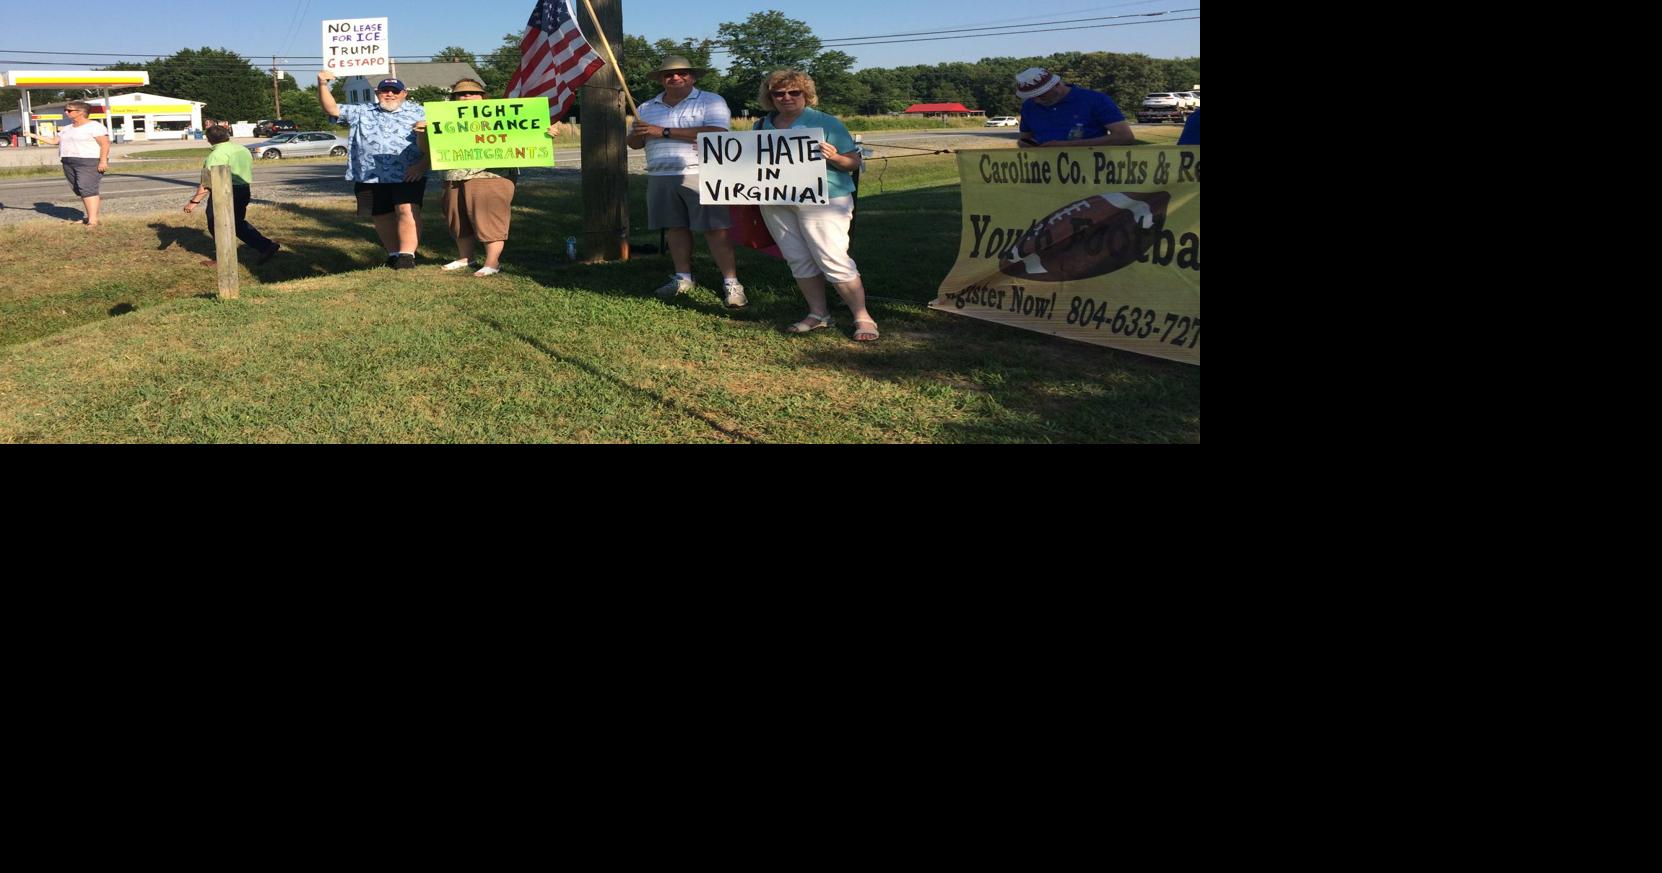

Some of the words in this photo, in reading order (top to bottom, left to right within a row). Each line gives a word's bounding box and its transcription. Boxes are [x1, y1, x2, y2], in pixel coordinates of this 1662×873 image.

[328, 22, 351, 33] NO
[353, 23, 383, 33] LEASE
[332, 34, 352, 42] FOR
[329, 44, 380, 56] TRUMP
[327, 57, 385, 69] GESTAPO
[457, 103, 524, 119] FIGHT
[432, 118, 540, 135] IGNORANCE
[475, 133, 508, 144] NOT
[436, 146, 549, 162] IMMIGRANTS
[702, 135, 742, 165] NO
[756, 133, 822, 165] HATE
[757, 167, 781, 182] IN
[979, 151, 1052, 185] Caroline
[1056, 151, 1087, 185] Co.
[1093, 152, 1149, 185] Parks
[1152, 150, 1171, 185] &
[705, 176, 826, 204] VIRGINIA!
[1009, 285, 1057, 320] Now!
